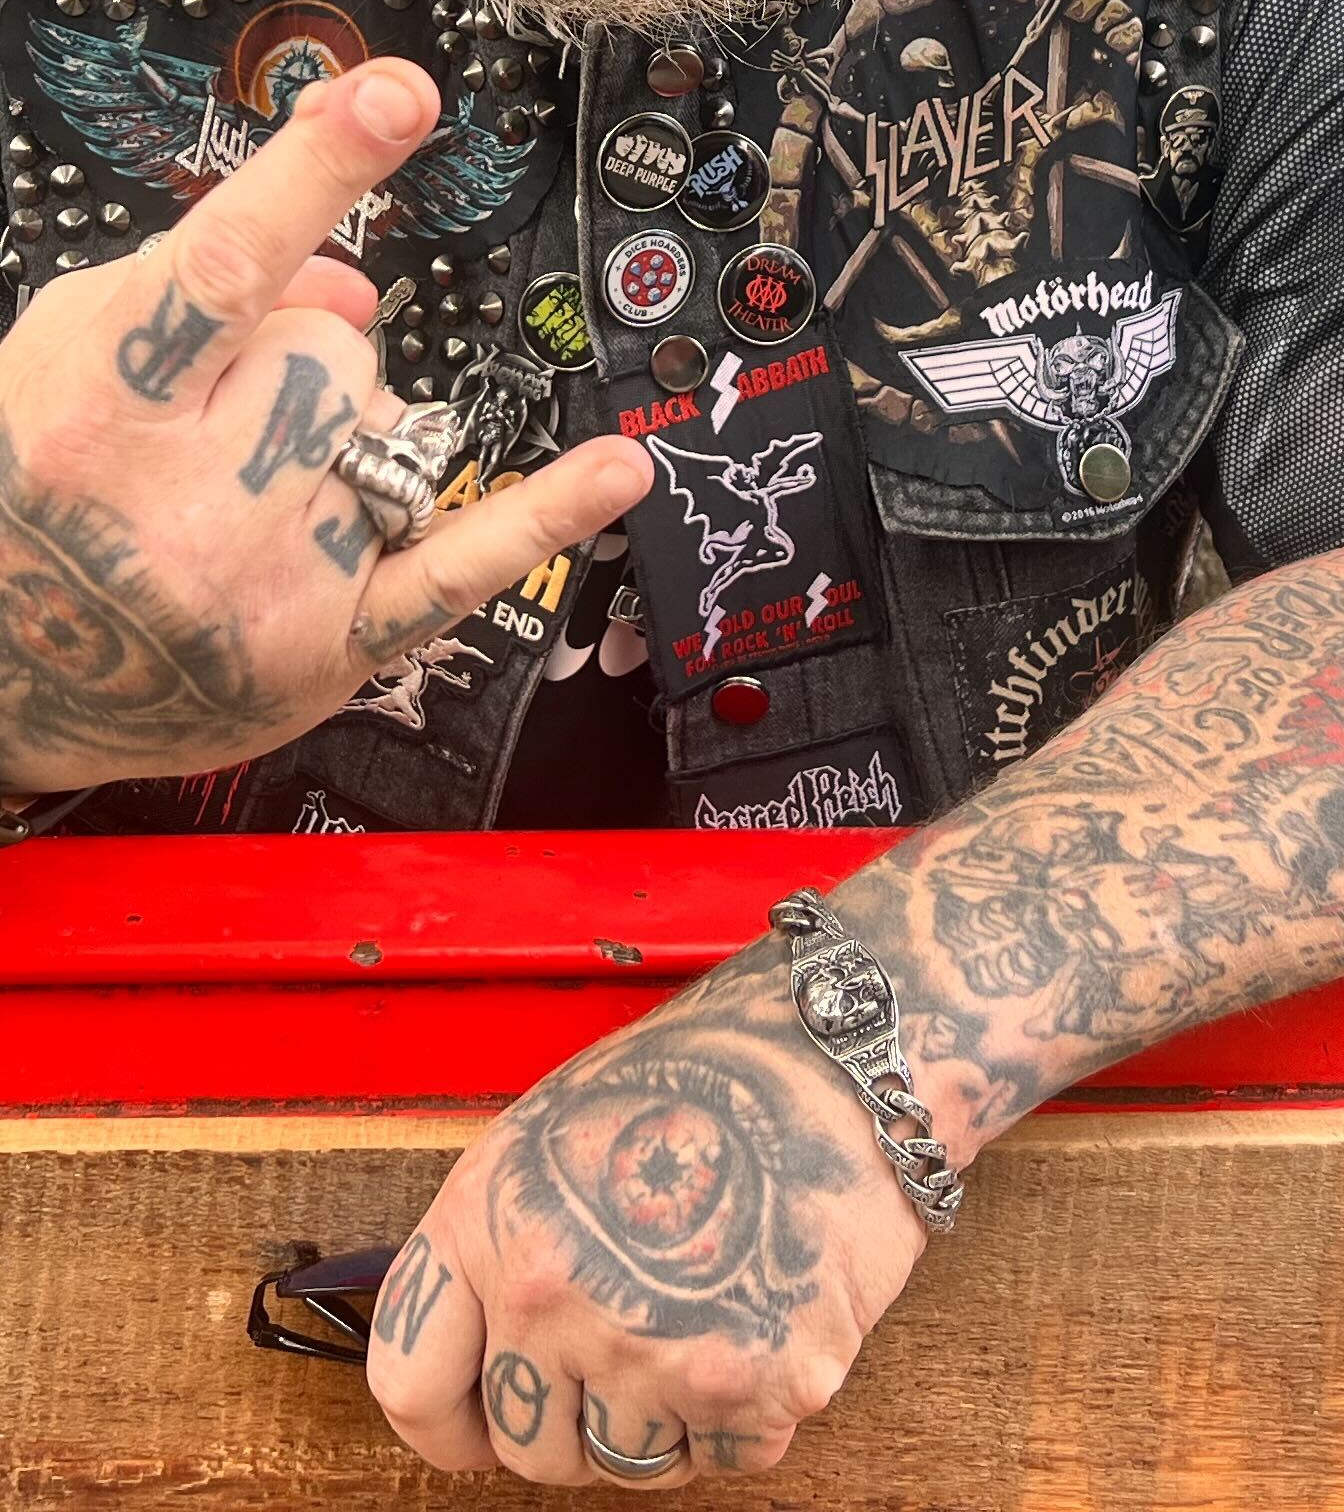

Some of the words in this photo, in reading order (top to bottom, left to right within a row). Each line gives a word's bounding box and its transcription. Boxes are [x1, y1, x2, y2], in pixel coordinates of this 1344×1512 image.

[687, 144, 744, 199] RUSH
[864, 67, 1052, 230] SLAYER
[604, 156, 635, 180] DEEP
[634, 168, 678, 195] PURPLE
[624, 240, 648, 260] DICE
[649, 238, 688, 278] HOARDERS
[746, 254, 802, 287] DREAM
[622, 303, 649, 318] CLUB
[726, 299, 795, 333] THEATER
[618, 392, 703, 439] BLACK
[492, 599, 545, 642] END
[672, 631, 704, 660] WE
[761, 595, 805, 624] OUR
[722, 631, 769, 657] ROCK
[810, 606, 855, 634] ROLL
[978, 576, 1134, 762] itchfinder
[694, 771, 809, 830] Sacred
[803, 749, 903, 830] Reich
